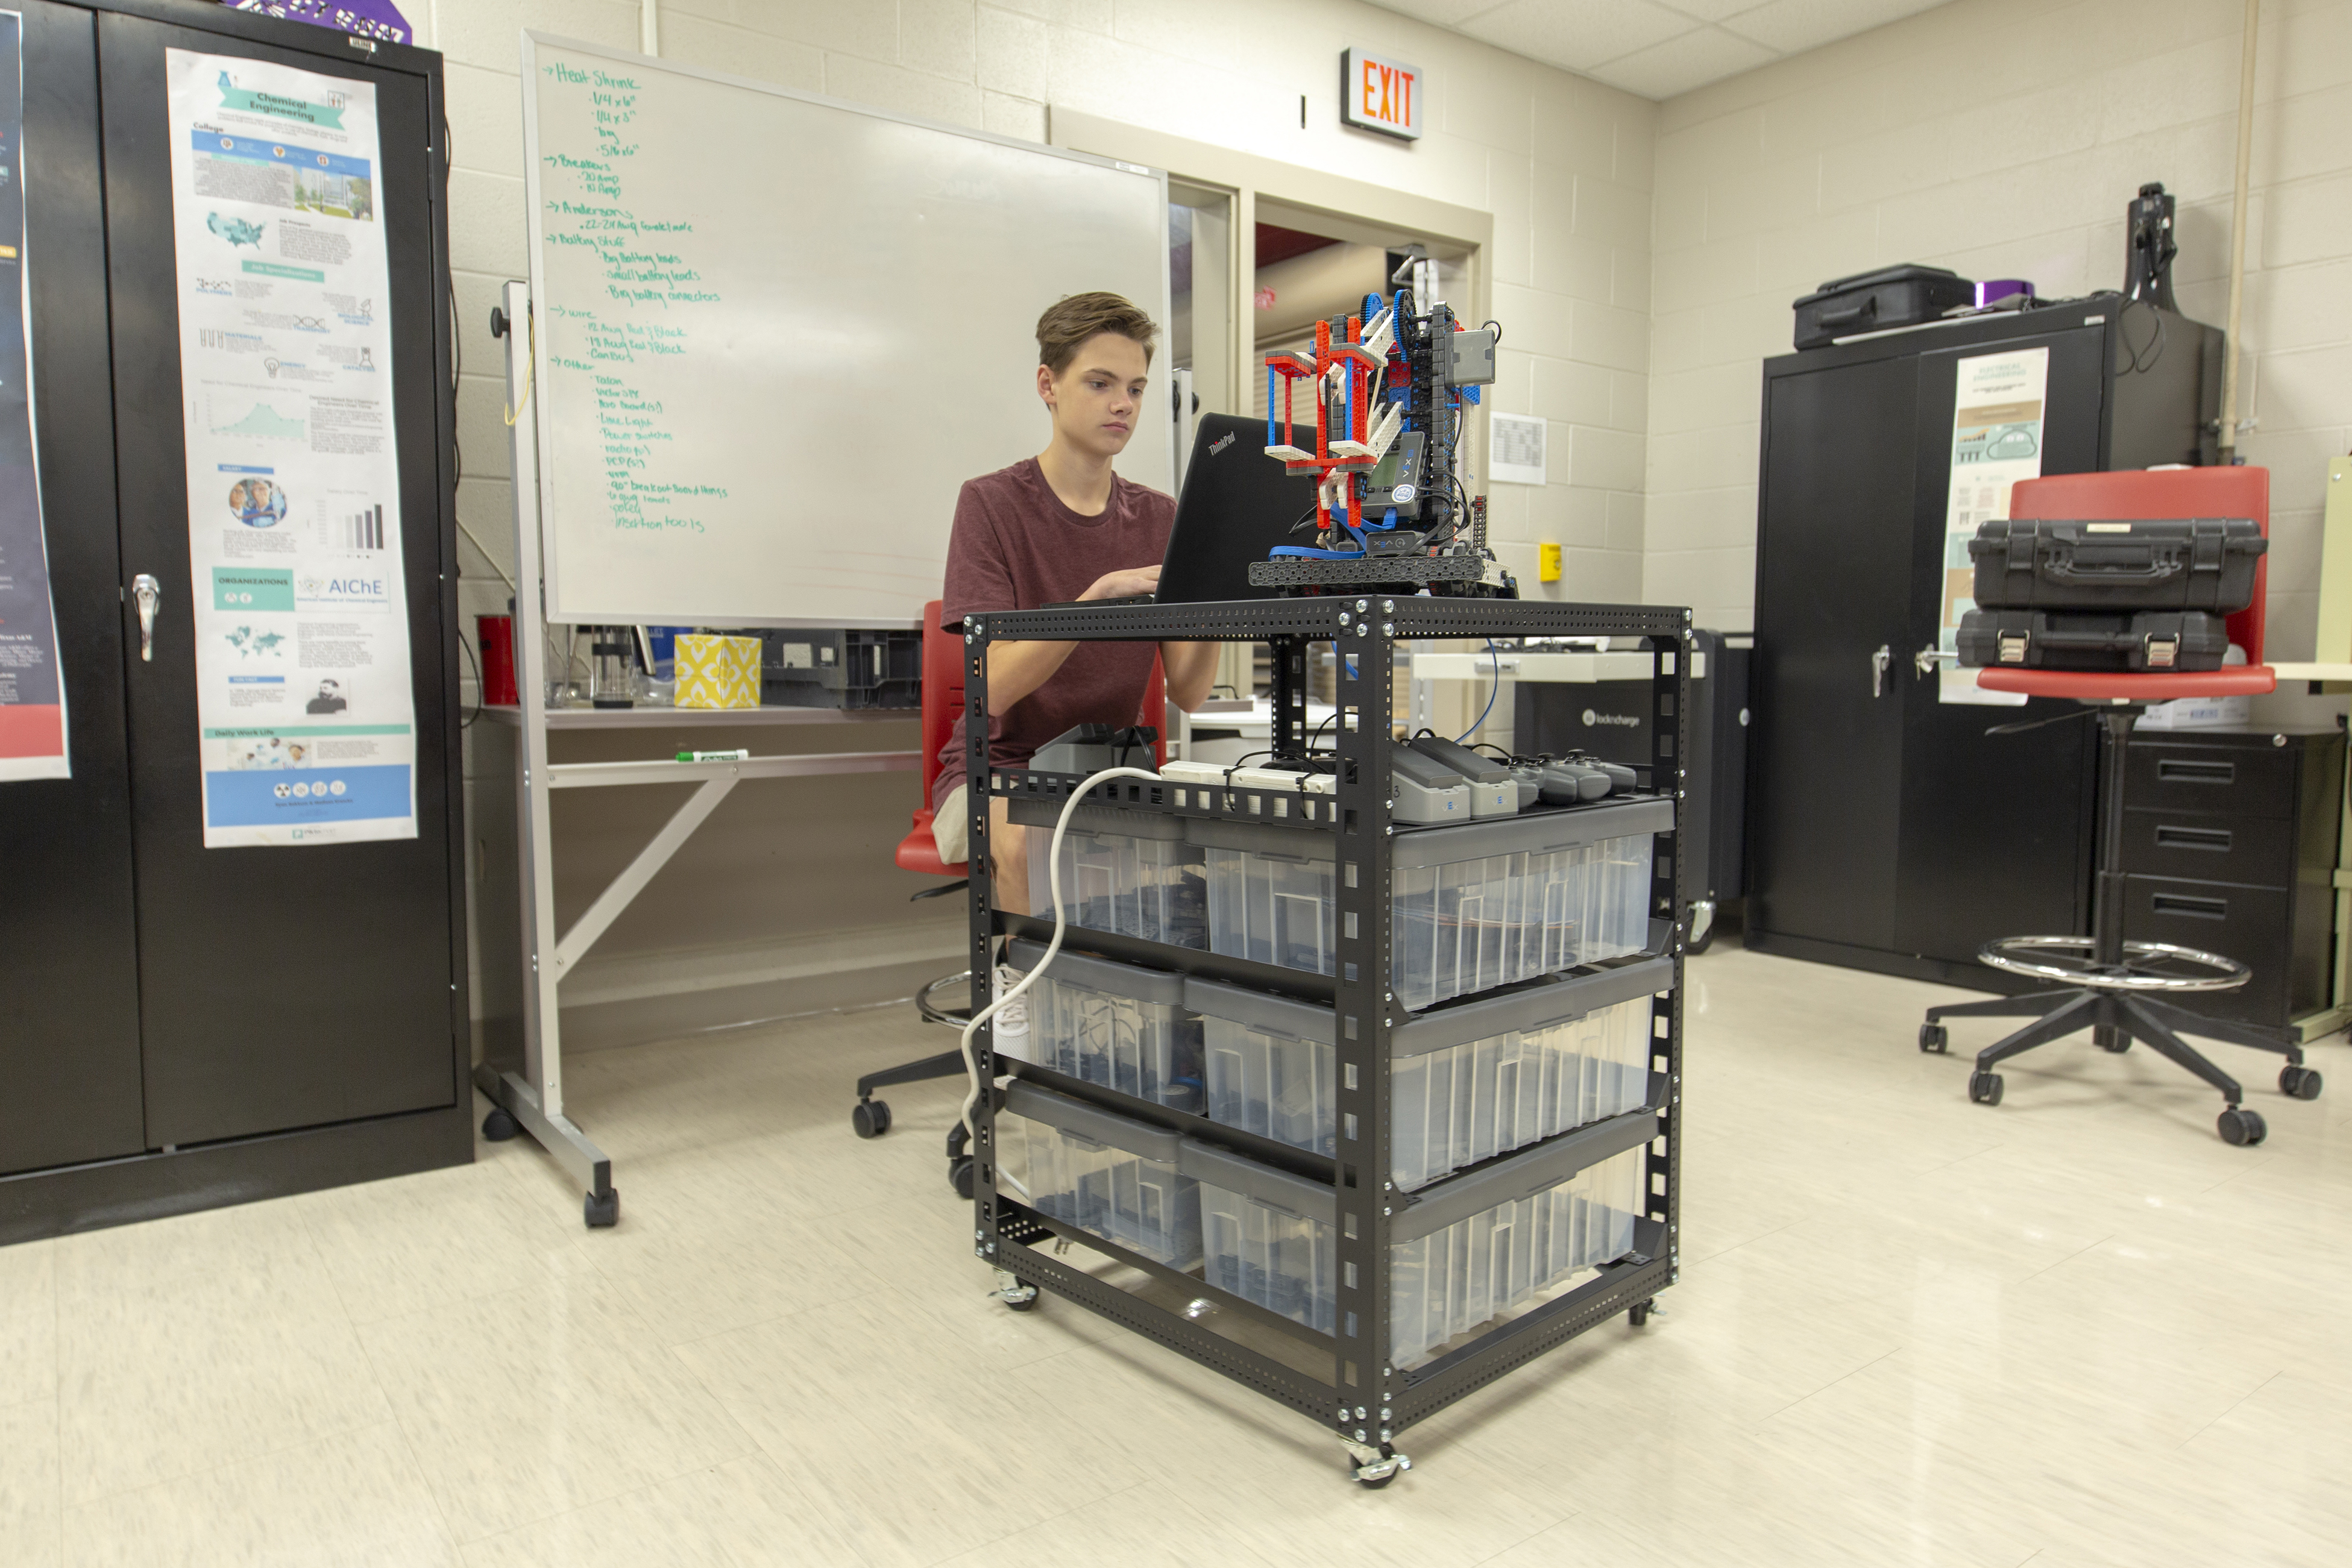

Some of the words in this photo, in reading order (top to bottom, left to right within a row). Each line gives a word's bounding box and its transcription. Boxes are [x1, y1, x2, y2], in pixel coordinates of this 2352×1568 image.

[556, 63, 590, 83] Heat
[593, 70, 641, 89] Shrink
[257, 92, 307, 110] Chemical
[1363, 58, 1414, 128] EXIT
[250, 101, 315, 122] Engineering
[193, 122, 224, 133] College
[558, 154, 611, 171] Breakers
[251, 263, 264, 272] Job
[1208, 430, 1236, 456] ThinkPad
[1402, 458, 1412, 478] VEX
[1374, 540, 1394, 548] VEX
[218, 577, 289, 586] ORGANIZATIONS
[329, 579, 383, 595] AIChE
[215, 729, 236, 738] Daily
[1393, 785, 1401, 798] 3
[1441, 801, 1459, 812] VEX
